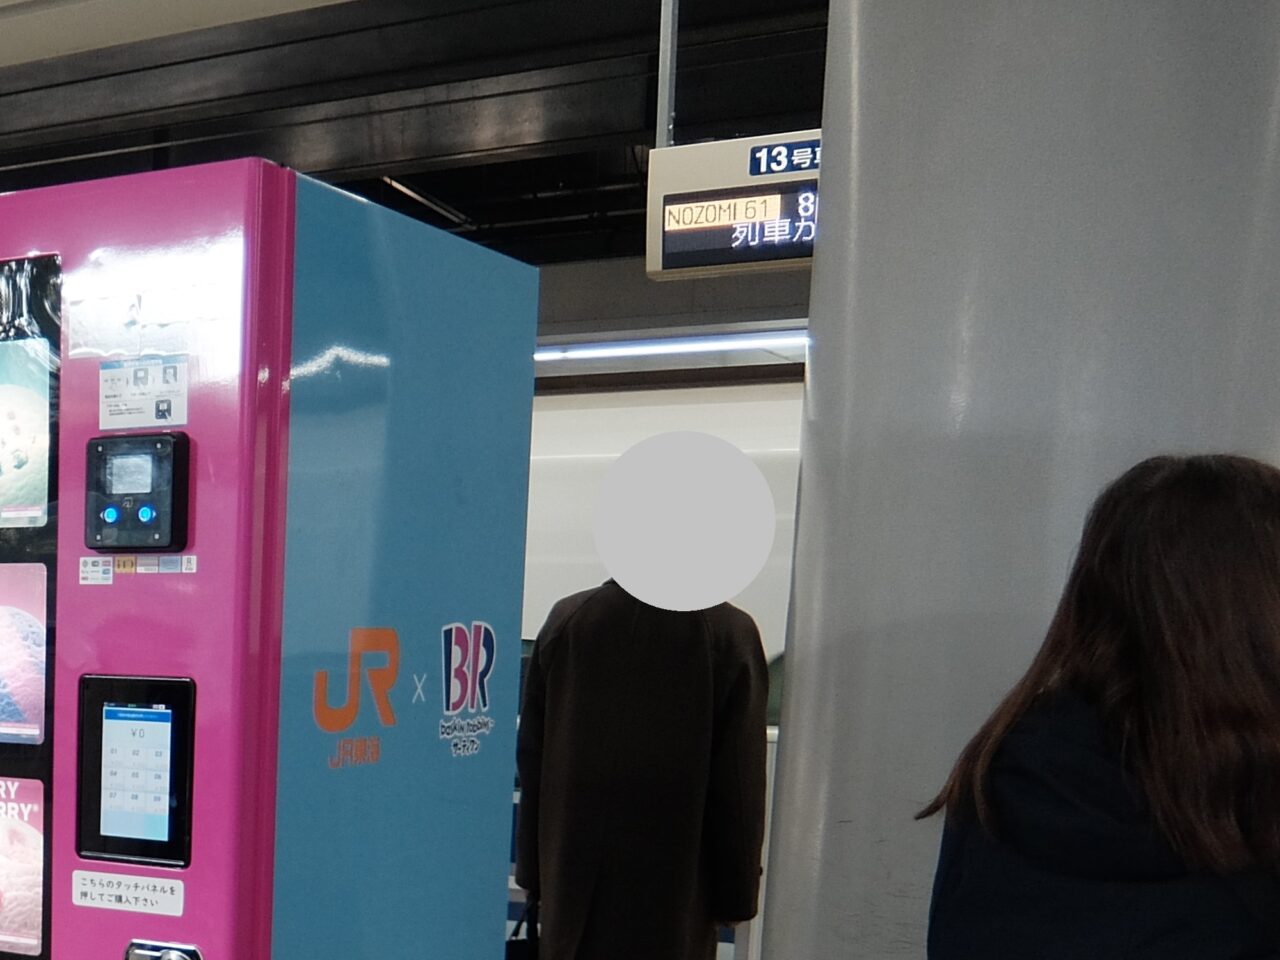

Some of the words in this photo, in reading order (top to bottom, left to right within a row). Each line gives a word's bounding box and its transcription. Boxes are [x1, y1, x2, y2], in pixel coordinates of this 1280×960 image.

[668, 201, 737, 226] NOZOMI
[744, 199, 768, 220] 61
[313, 626, 401, 734] JR
[441, 620, 496, 715] BR
[80, 877, 176, 896] こちらのタッチパネルを
